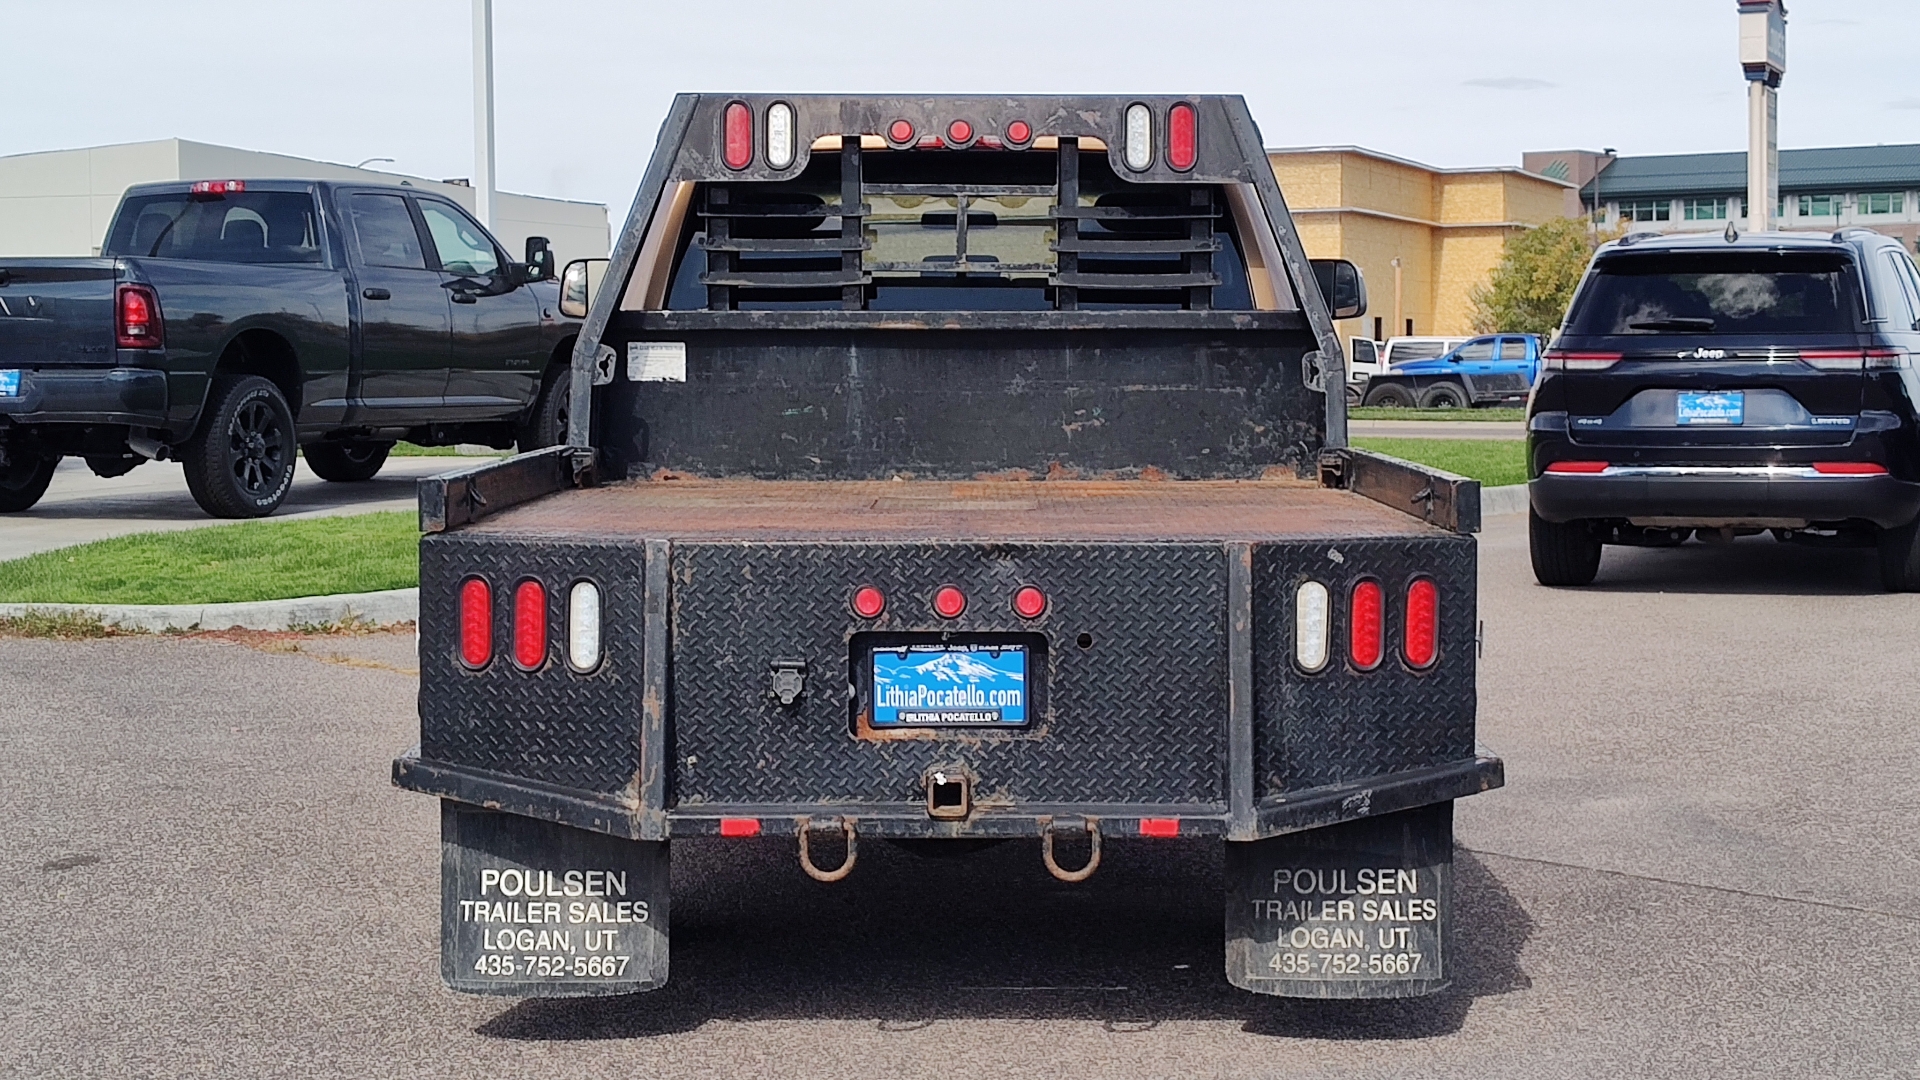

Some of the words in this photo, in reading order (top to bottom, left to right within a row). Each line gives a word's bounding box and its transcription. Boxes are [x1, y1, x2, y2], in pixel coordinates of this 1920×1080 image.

[1693, 347, 1725, 359] Jeep
[876, 684, 1021, 707] LithiaPocatello.com
[941, 712, 992, 722] POCATELLO
[481, 868, 627, 897] POULSEN
[1273, 868, 1418, 895] POULSEN
[459, 900, 561, 924] TRAILER
[568, 901, 649, 924] SALES
[1251, 899, 1355, 921] TRAILER
[1362, 899, 1437, 922] SALES
[483, 928, 576, 955] LOGAN,
[585, 929, 619, 951] UT
[1277, 927, 1370, 952] LOGAN,
[474, 955, 630, 977] 435-752-5667
[1268, 952, 1422, 975] 435-752-5667
